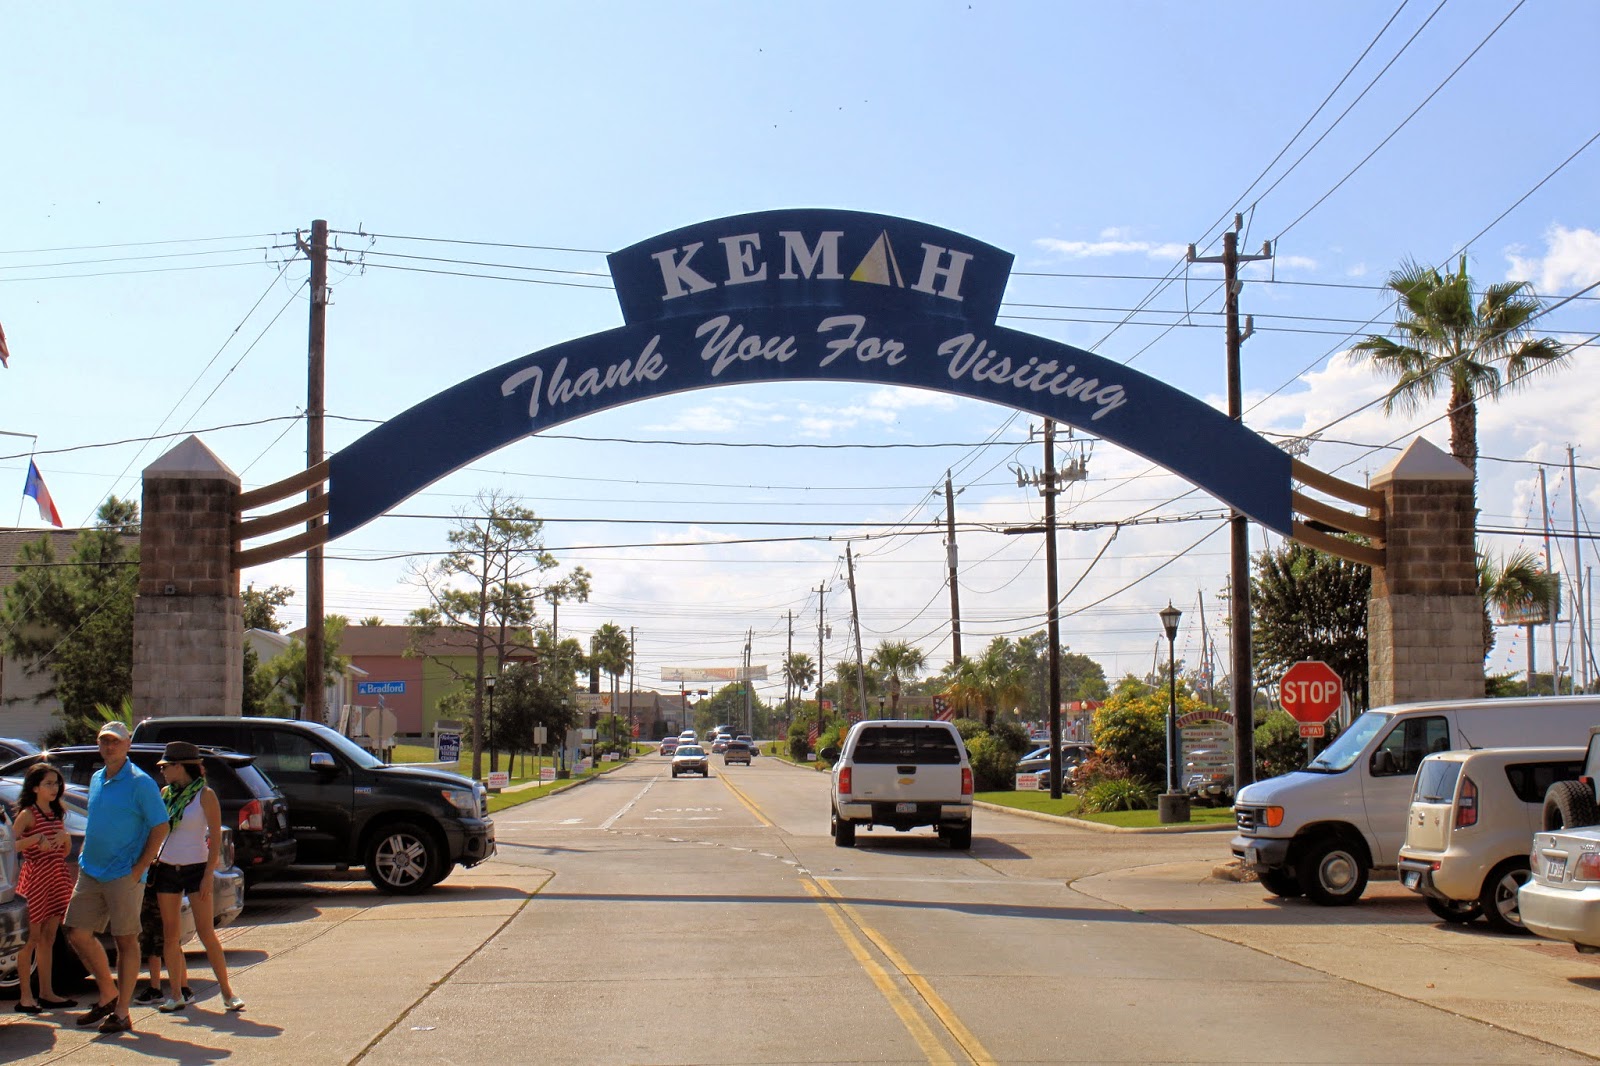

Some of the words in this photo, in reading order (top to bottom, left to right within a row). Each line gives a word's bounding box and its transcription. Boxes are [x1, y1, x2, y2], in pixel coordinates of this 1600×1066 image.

[652, 229, 974, 301] KEMAH
[501, 334, 668, 418] Thank
[695, 315, 797, 377] You
[817, 314, 907, 367] For
[937, 333, 1127, 421] Visiting
[367, 683, 404, 693] Bradford
[1284, 681, 1338, 704] STOP
[1301, 727, 1322, 735] 4-WAY
